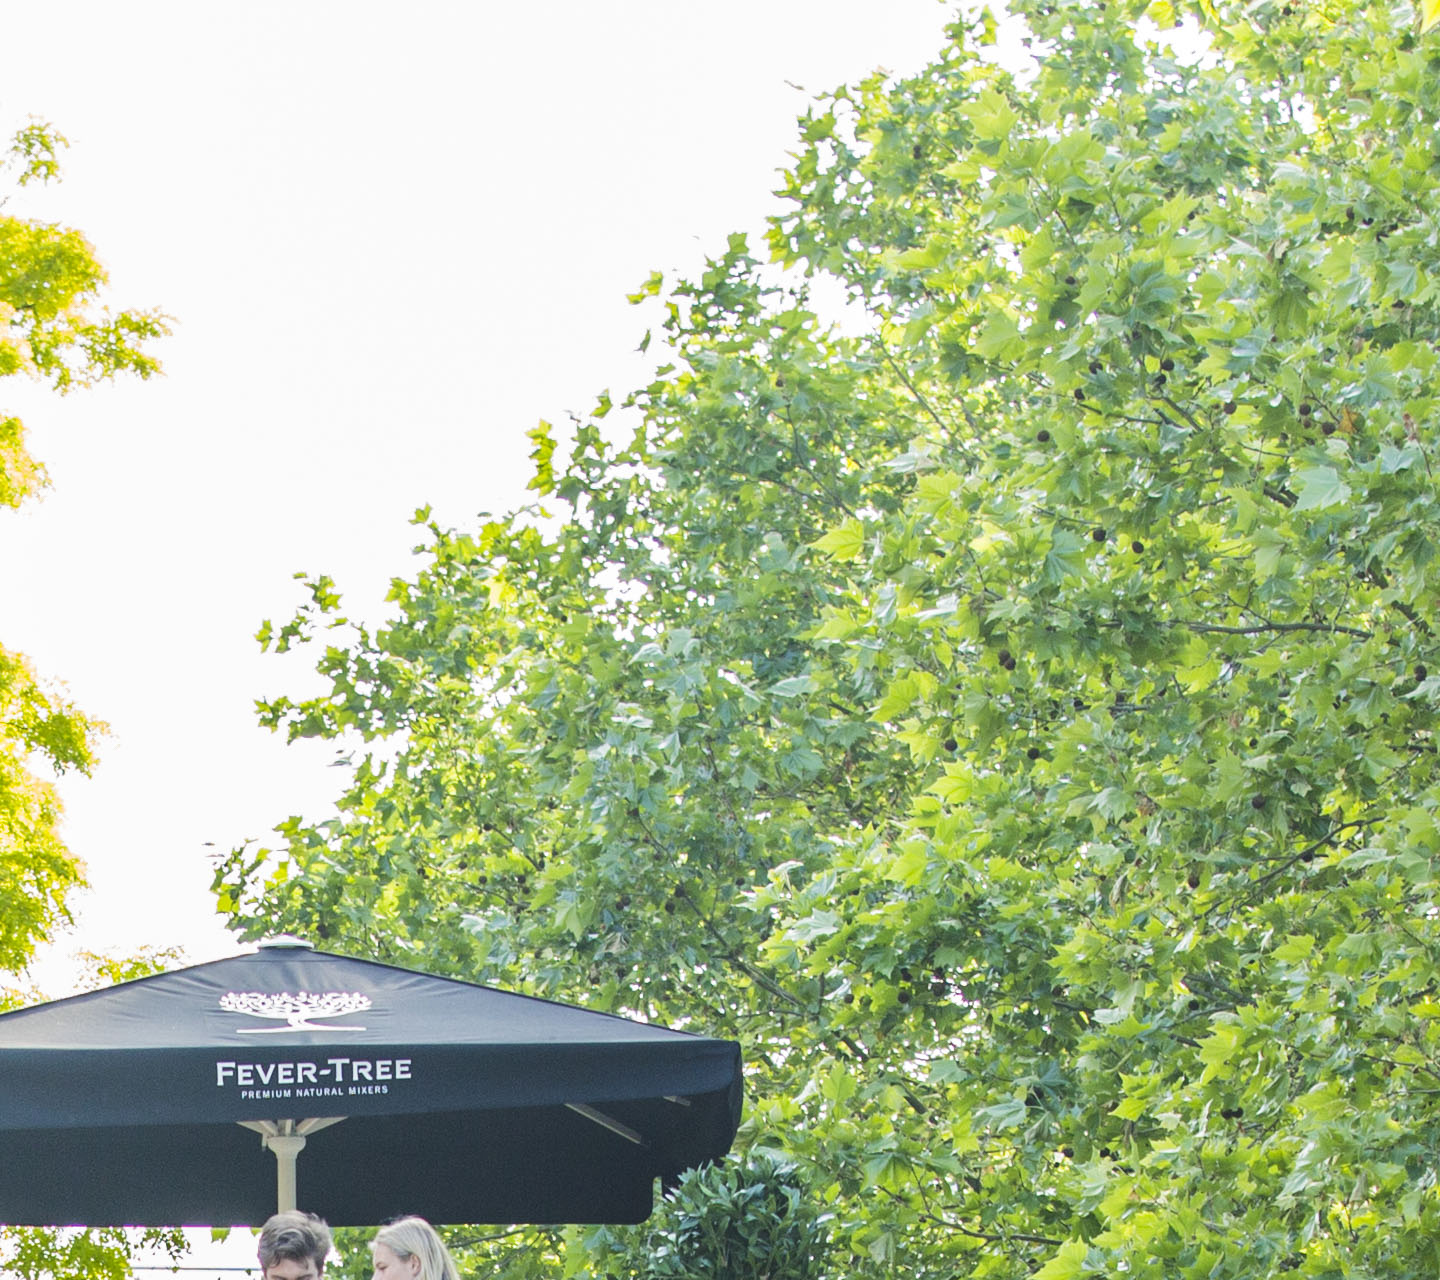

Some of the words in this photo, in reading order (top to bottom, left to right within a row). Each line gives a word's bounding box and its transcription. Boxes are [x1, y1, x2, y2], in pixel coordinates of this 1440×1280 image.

[216, 1058, 412, 1086] FEVER-TREE
[241, 1088, 291, 1100] PREMIUM
[296, 1086, 343, 1097] NATURAL
[348, 1085, 388, 1095] MIXERS
